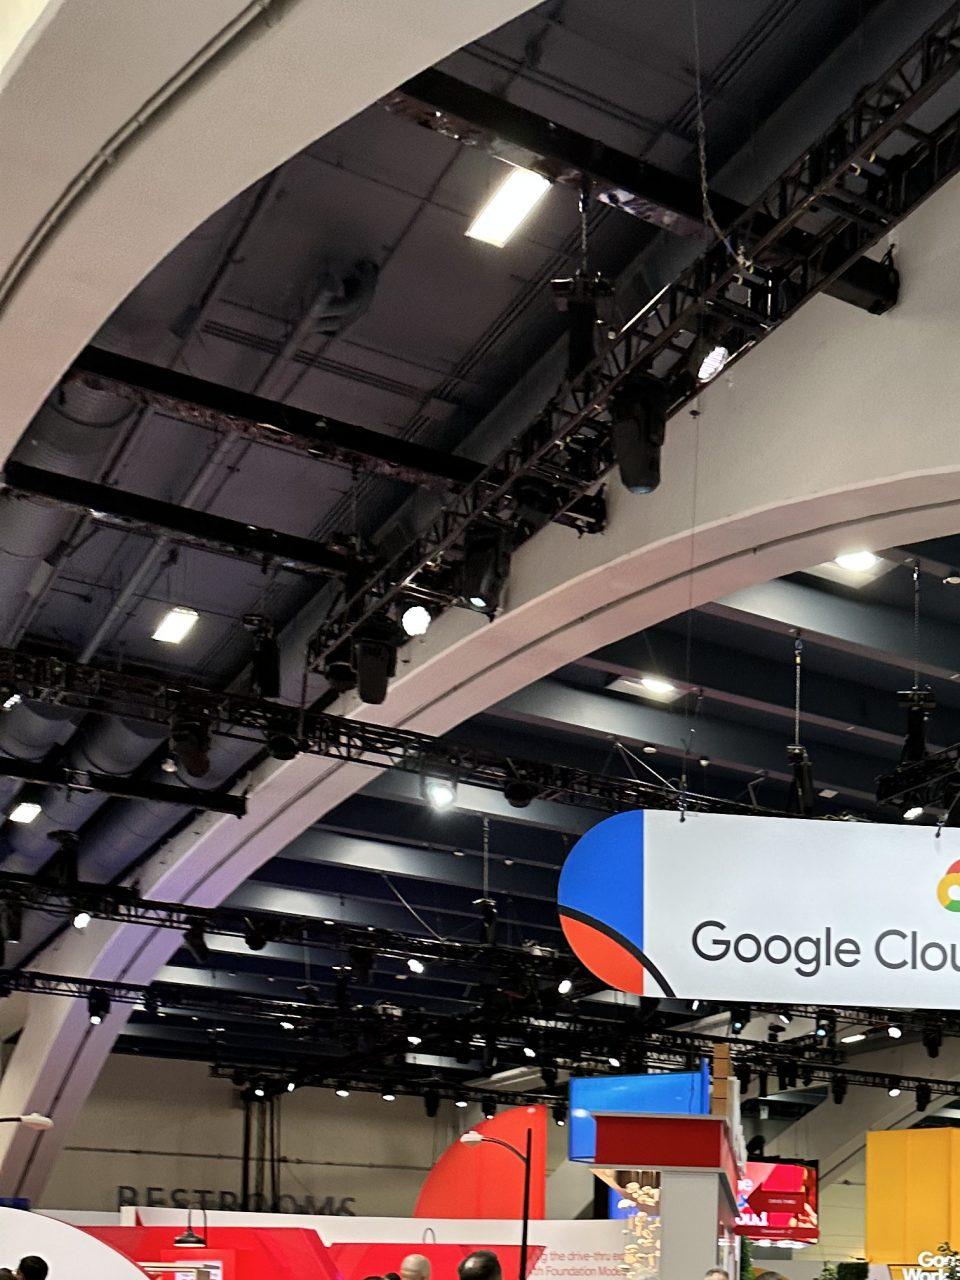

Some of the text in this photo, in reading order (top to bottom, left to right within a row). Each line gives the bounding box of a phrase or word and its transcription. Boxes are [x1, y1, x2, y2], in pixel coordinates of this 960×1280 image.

[691, 919, 862, 978] Google
[118, 1185, 357, 1217] RESTROOMS
[550, 1251, 565, 1261] the
[567, 1251, 611, 1262] drive-thru
[546, 1265, 597, 1277] Foundation
